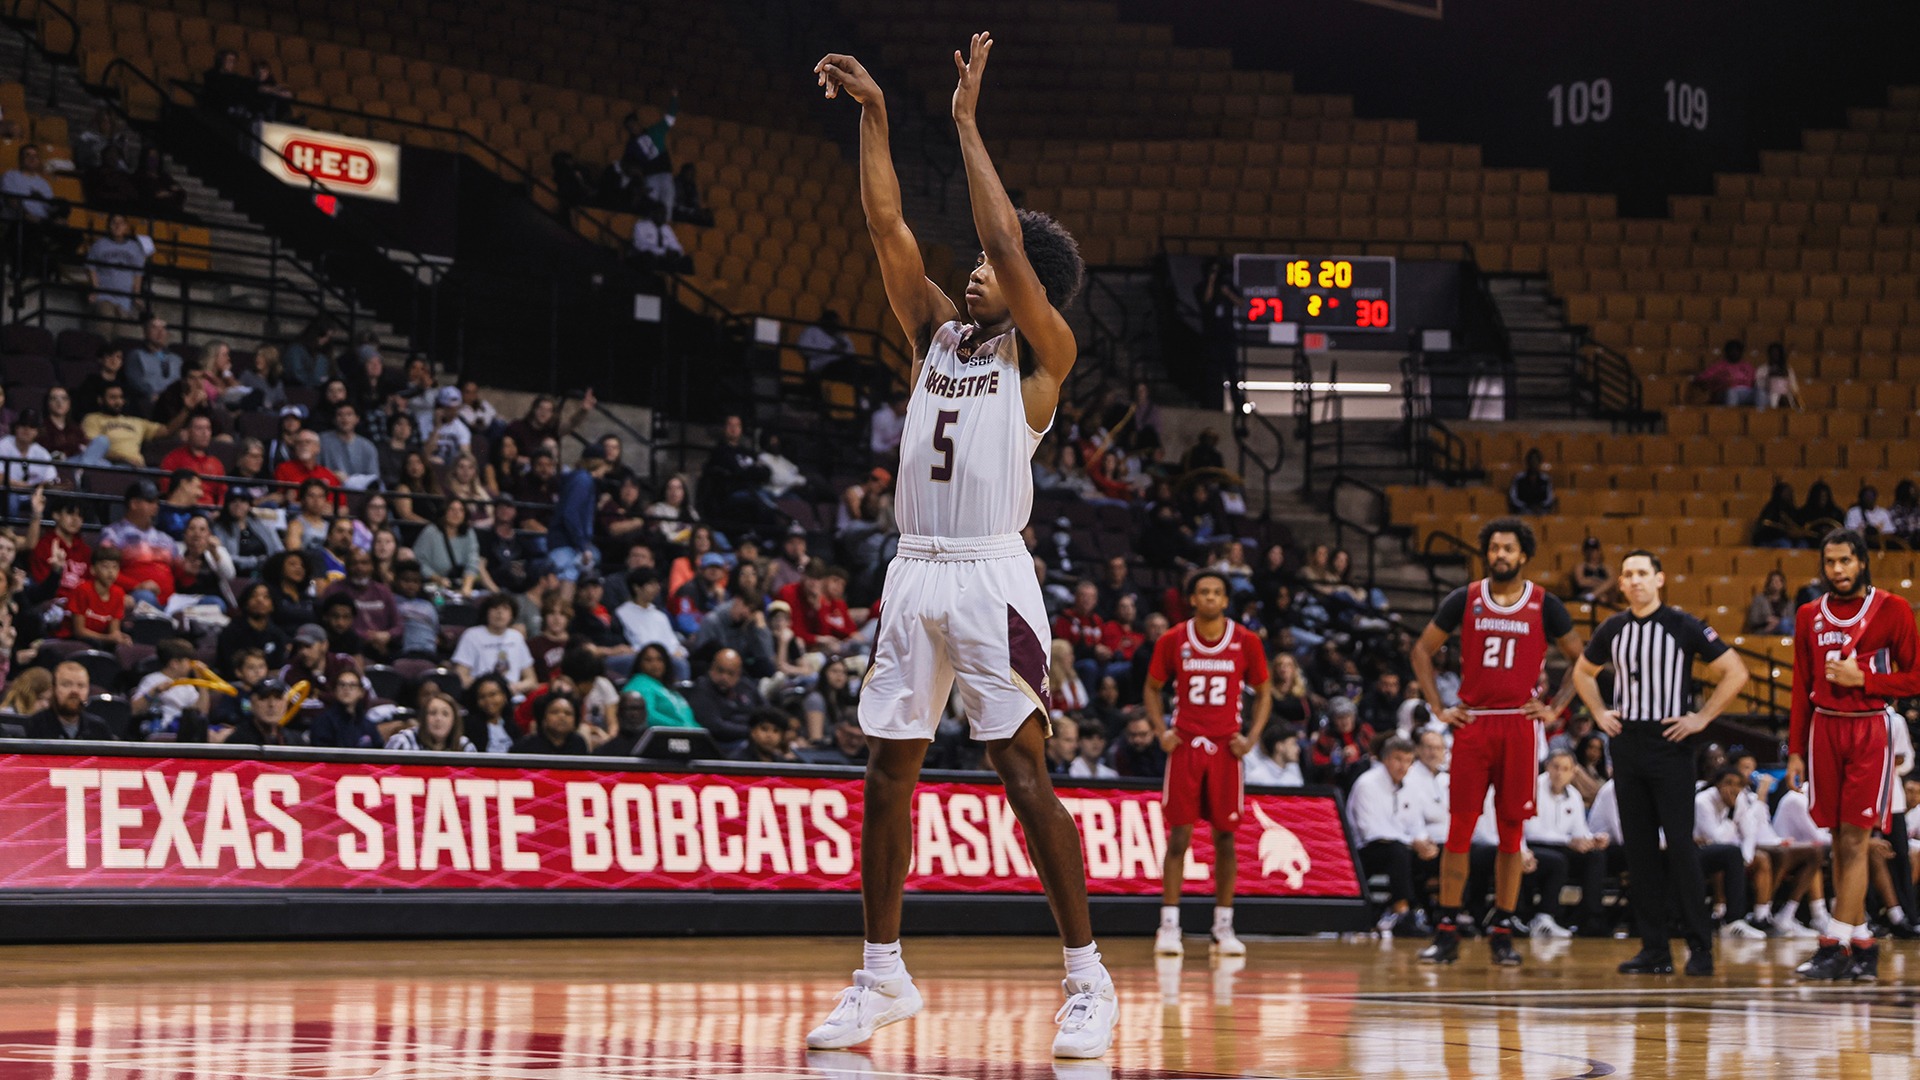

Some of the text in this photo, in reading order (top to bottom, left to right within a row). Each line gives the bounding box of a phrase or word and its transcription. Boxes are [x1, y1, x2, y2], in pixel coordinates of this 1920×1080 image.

[1547, 78, 1612, 127] 109
[1663, 79, 1708, 131] 109
[1356, 299, 1388, 327] 30
[930, 408, 960, 483] 5
[1474, 617, 1530, 635] LOUISIANA
[1182, 658, 1236, 672] LOUISIANA
[1482, 636, 1516, 669] 21
[1188, 675, 1227, 706] 22
[50, 768, 1210, 881] TEXAS STATE BOBCATS ASKBAL
